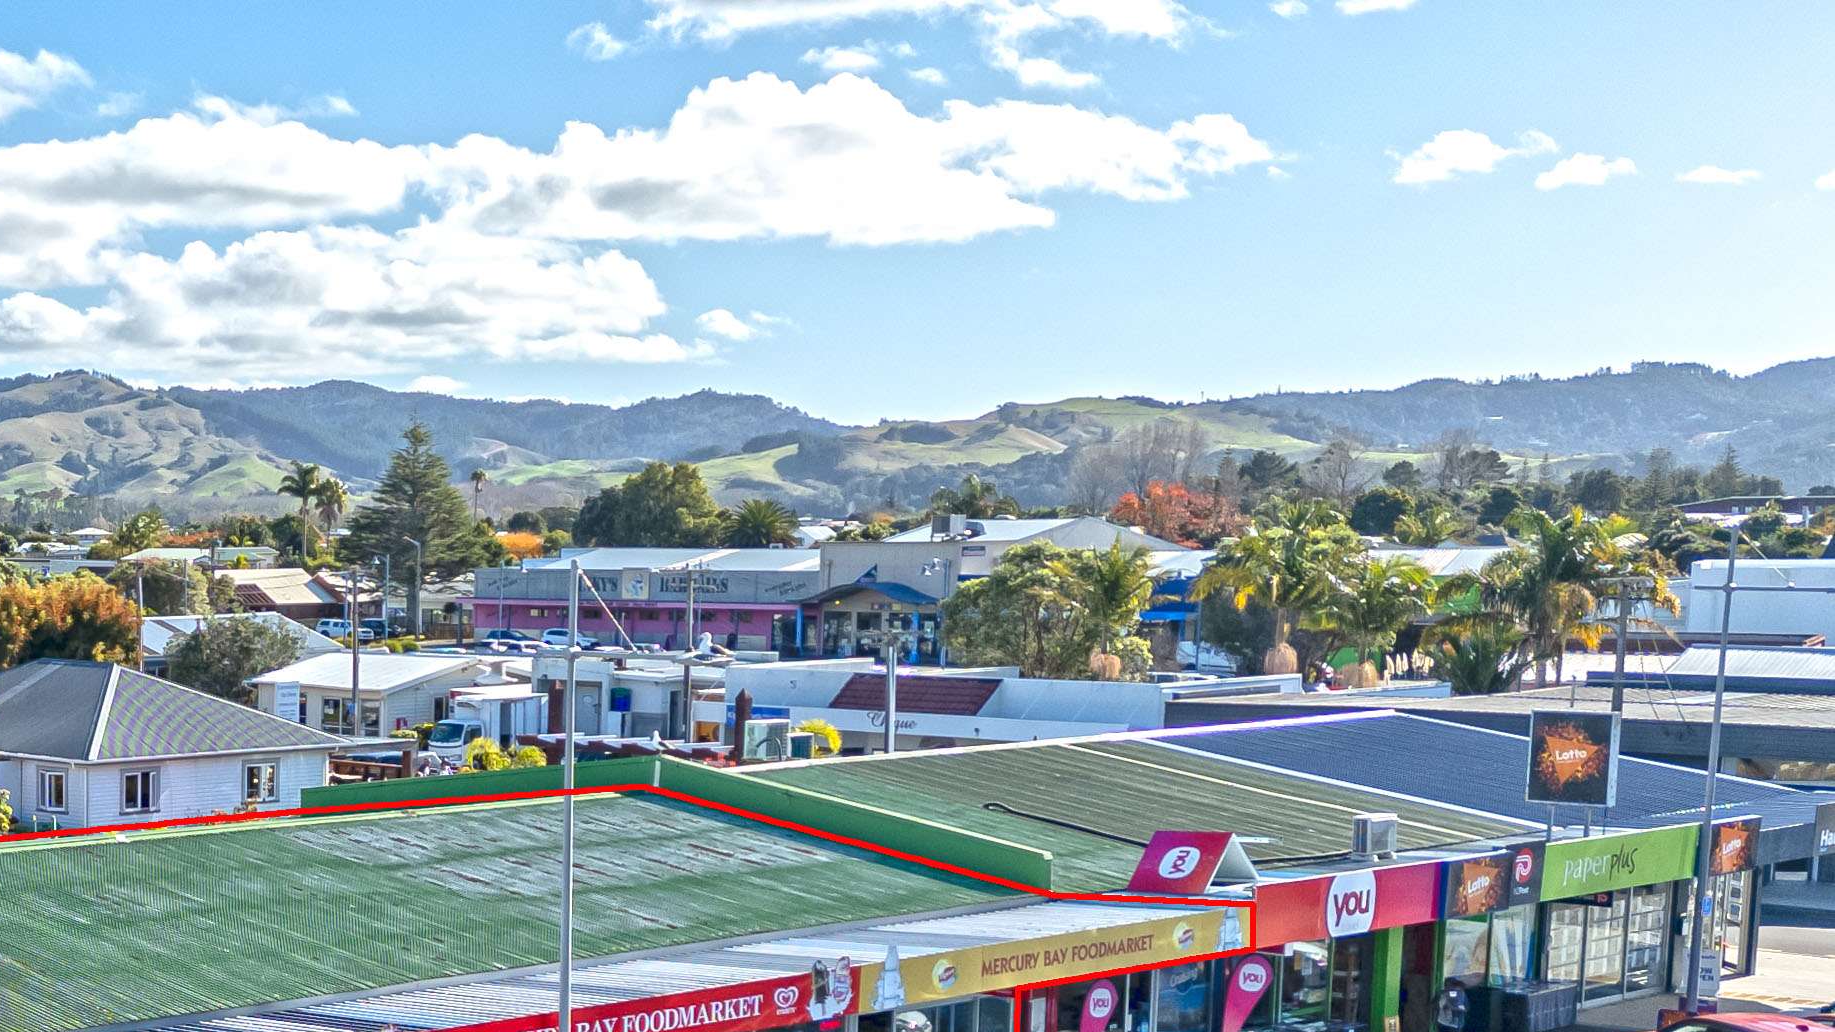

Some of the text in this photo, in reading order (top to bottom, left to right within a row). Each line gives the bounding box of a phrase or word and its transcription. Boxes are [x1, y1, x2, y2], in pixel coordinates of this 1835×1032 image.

[1555, 749, 1588, 761] Lotto
[1466, 876, 1490, 894] Lotto
[1334, 889, 1370, 927] you
[981, 954, 1039, 977] MERCURY
[1044, 948, 1068, 967] BAY
[1072, 934, 1155, 962] FOODMARKET
[1243, 972, 1263, 984] you
[1092, 997, 1110, 1010] you
